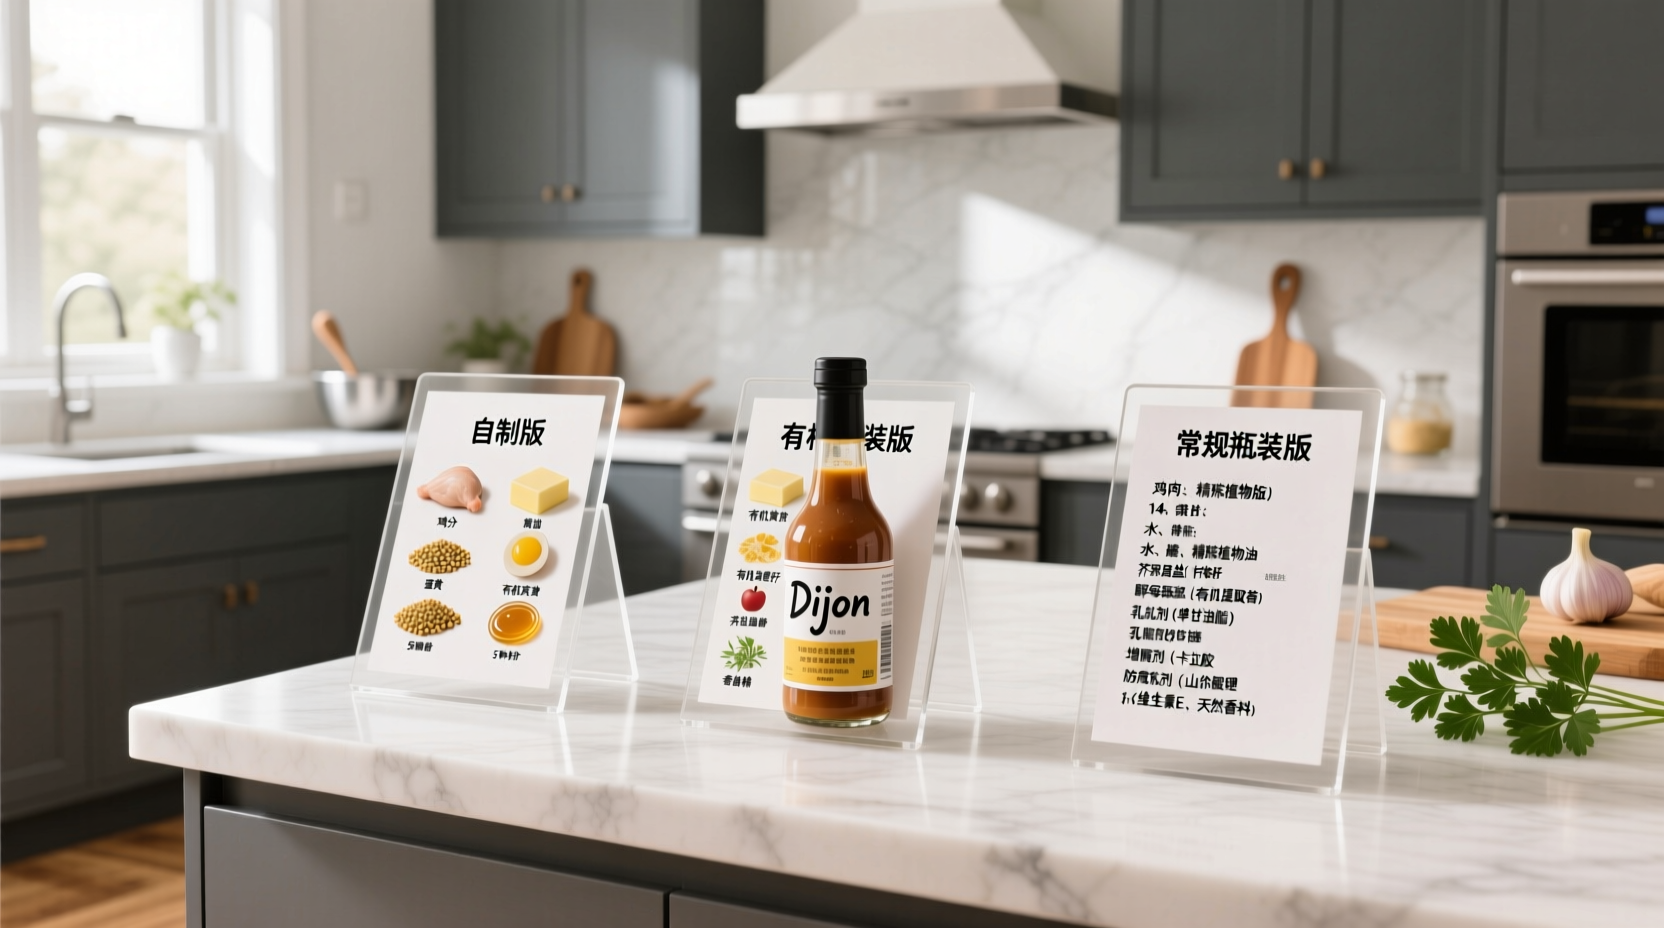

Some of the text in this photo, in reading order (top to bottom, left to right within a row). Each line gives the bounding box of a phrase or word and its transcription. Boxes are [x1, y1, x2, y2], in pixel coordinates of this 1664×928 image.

[472, 416, 547, 447] 自制版
[1177, 429, 1313, 462] 常规瓶装版
[790, 580, 870, 636] Dijon
